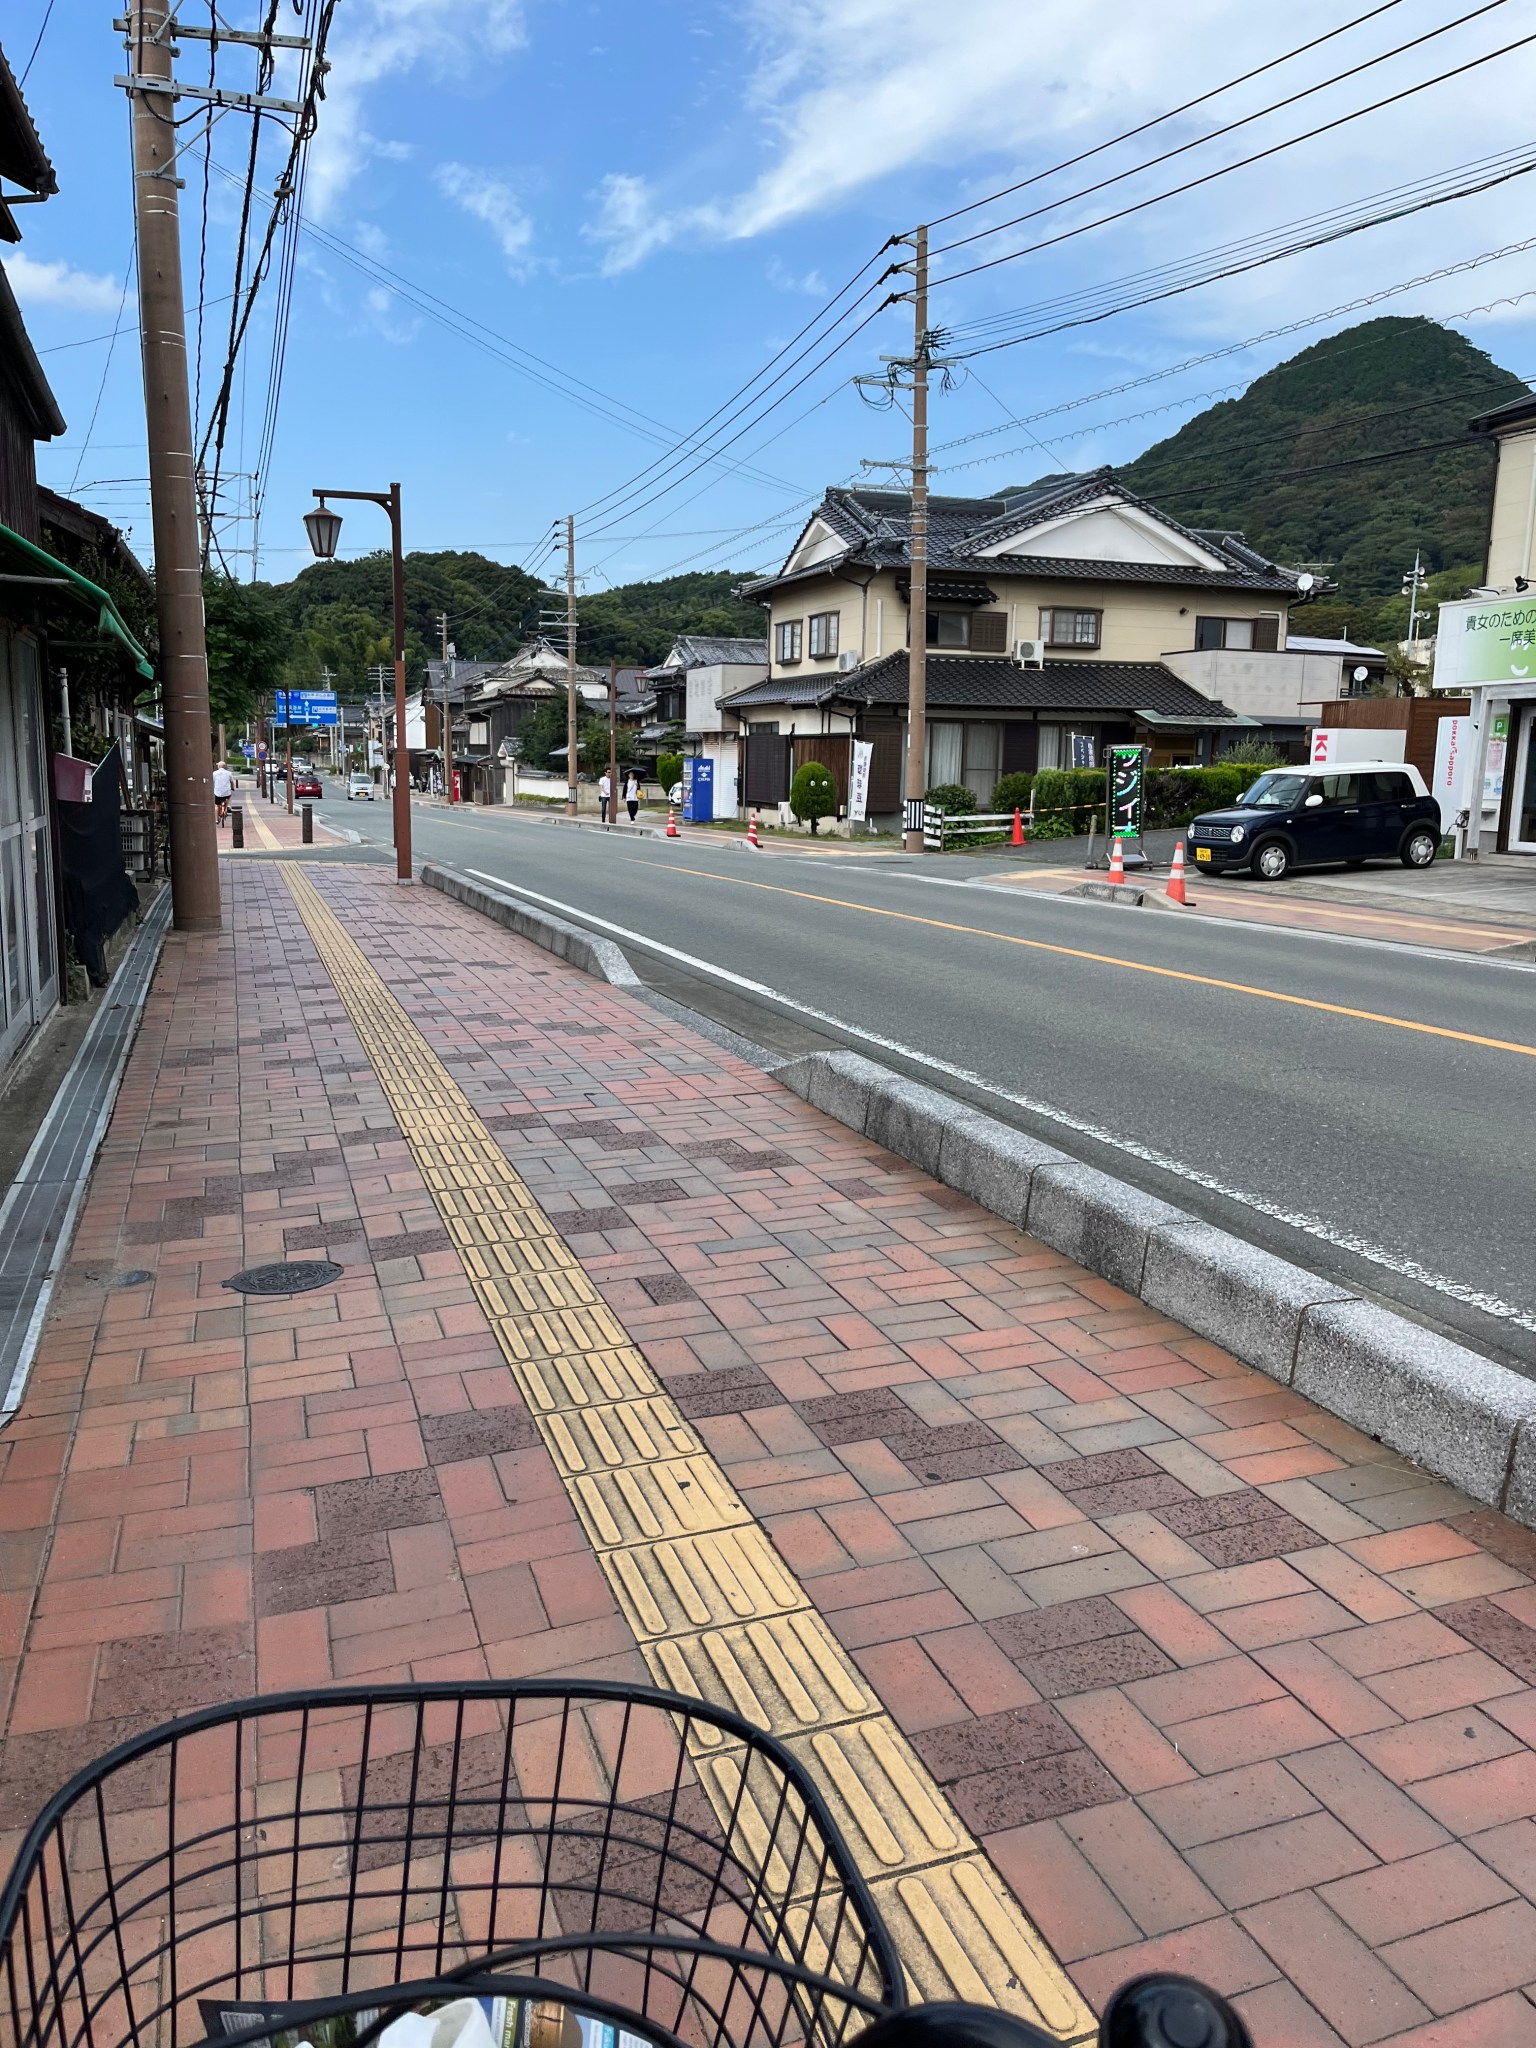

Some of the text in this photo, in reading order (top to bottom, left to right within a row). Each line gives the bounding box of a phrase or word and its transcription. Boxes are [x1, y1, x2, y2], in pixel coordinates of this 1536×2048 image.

[1466, 609, 1536, 632] 貴女のための
[1499, 629, 1536, 646] 一席美
[506, 2000, 516, 2028] Fresh
